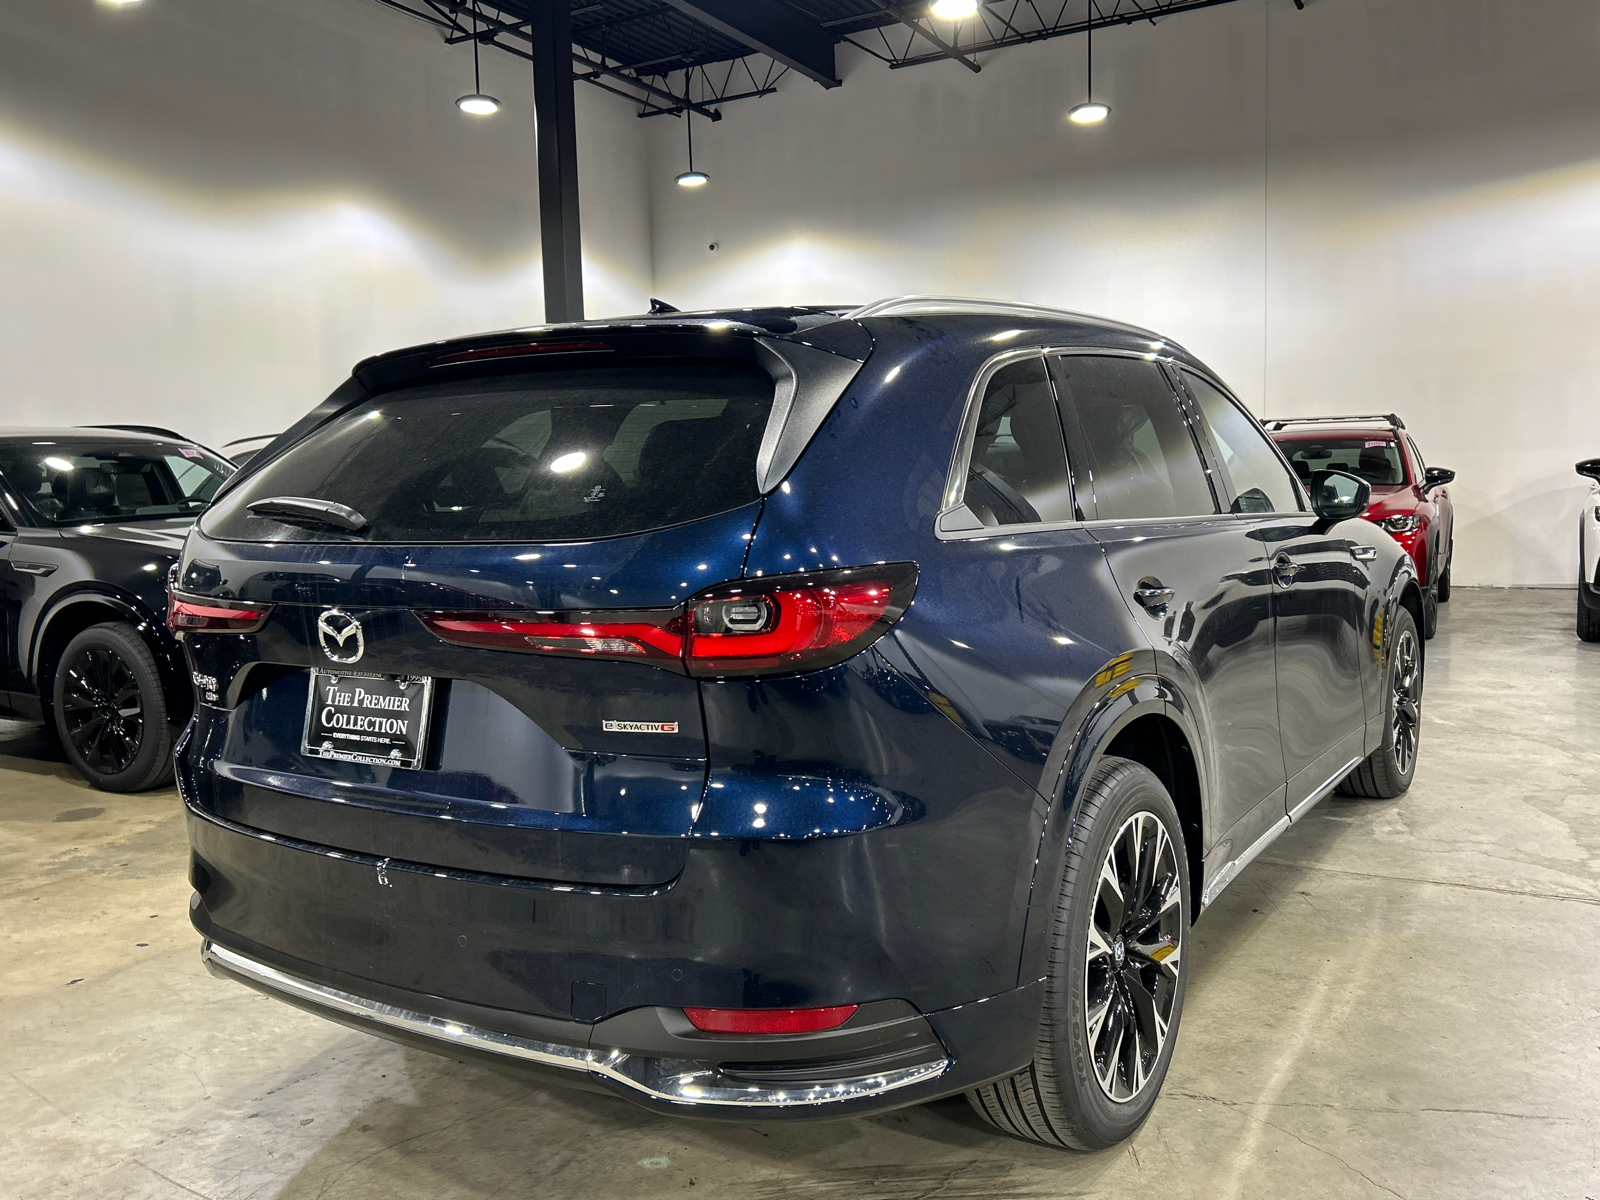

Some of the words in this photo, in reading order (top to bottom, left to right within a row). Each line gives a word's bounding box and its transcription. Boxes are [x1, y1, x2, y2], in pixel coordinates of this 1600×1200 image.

[325, 685, 352, 706] THE
[352, 687, 410, 712] PREMIER
[321, 706, 408, 735] COLLECTION
[332, 732, 360, 741] EVERYTHING
[360, 735, 377, 743] STARTS
[1072, 1021, 1088, 1088] TOYO
